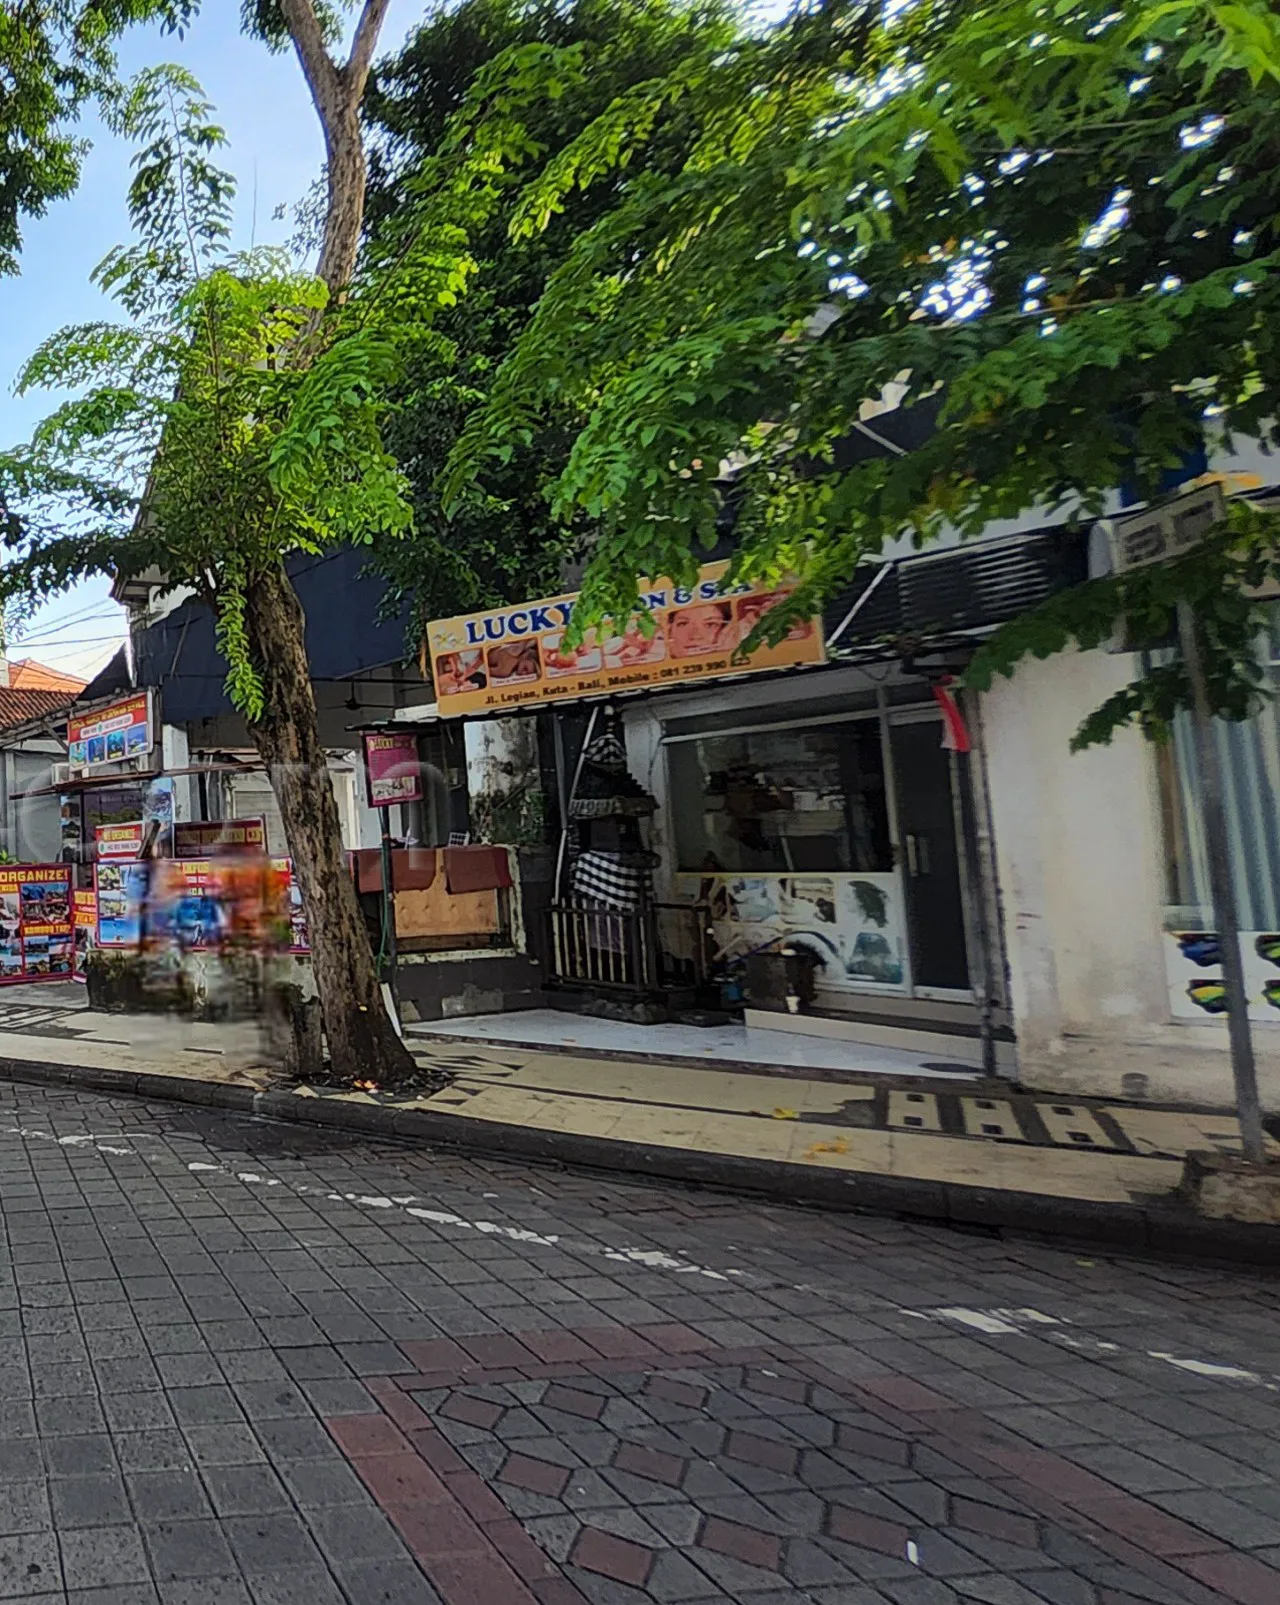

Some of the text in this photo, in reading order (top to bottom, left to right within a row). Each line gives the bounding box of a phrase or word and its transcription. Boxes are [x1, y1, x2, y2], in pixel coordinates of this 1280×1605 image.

[466, 601, 577, 643] LUCKY
[673, 586, 692, 604] &
[608, 673, 650, 686] Mobile
